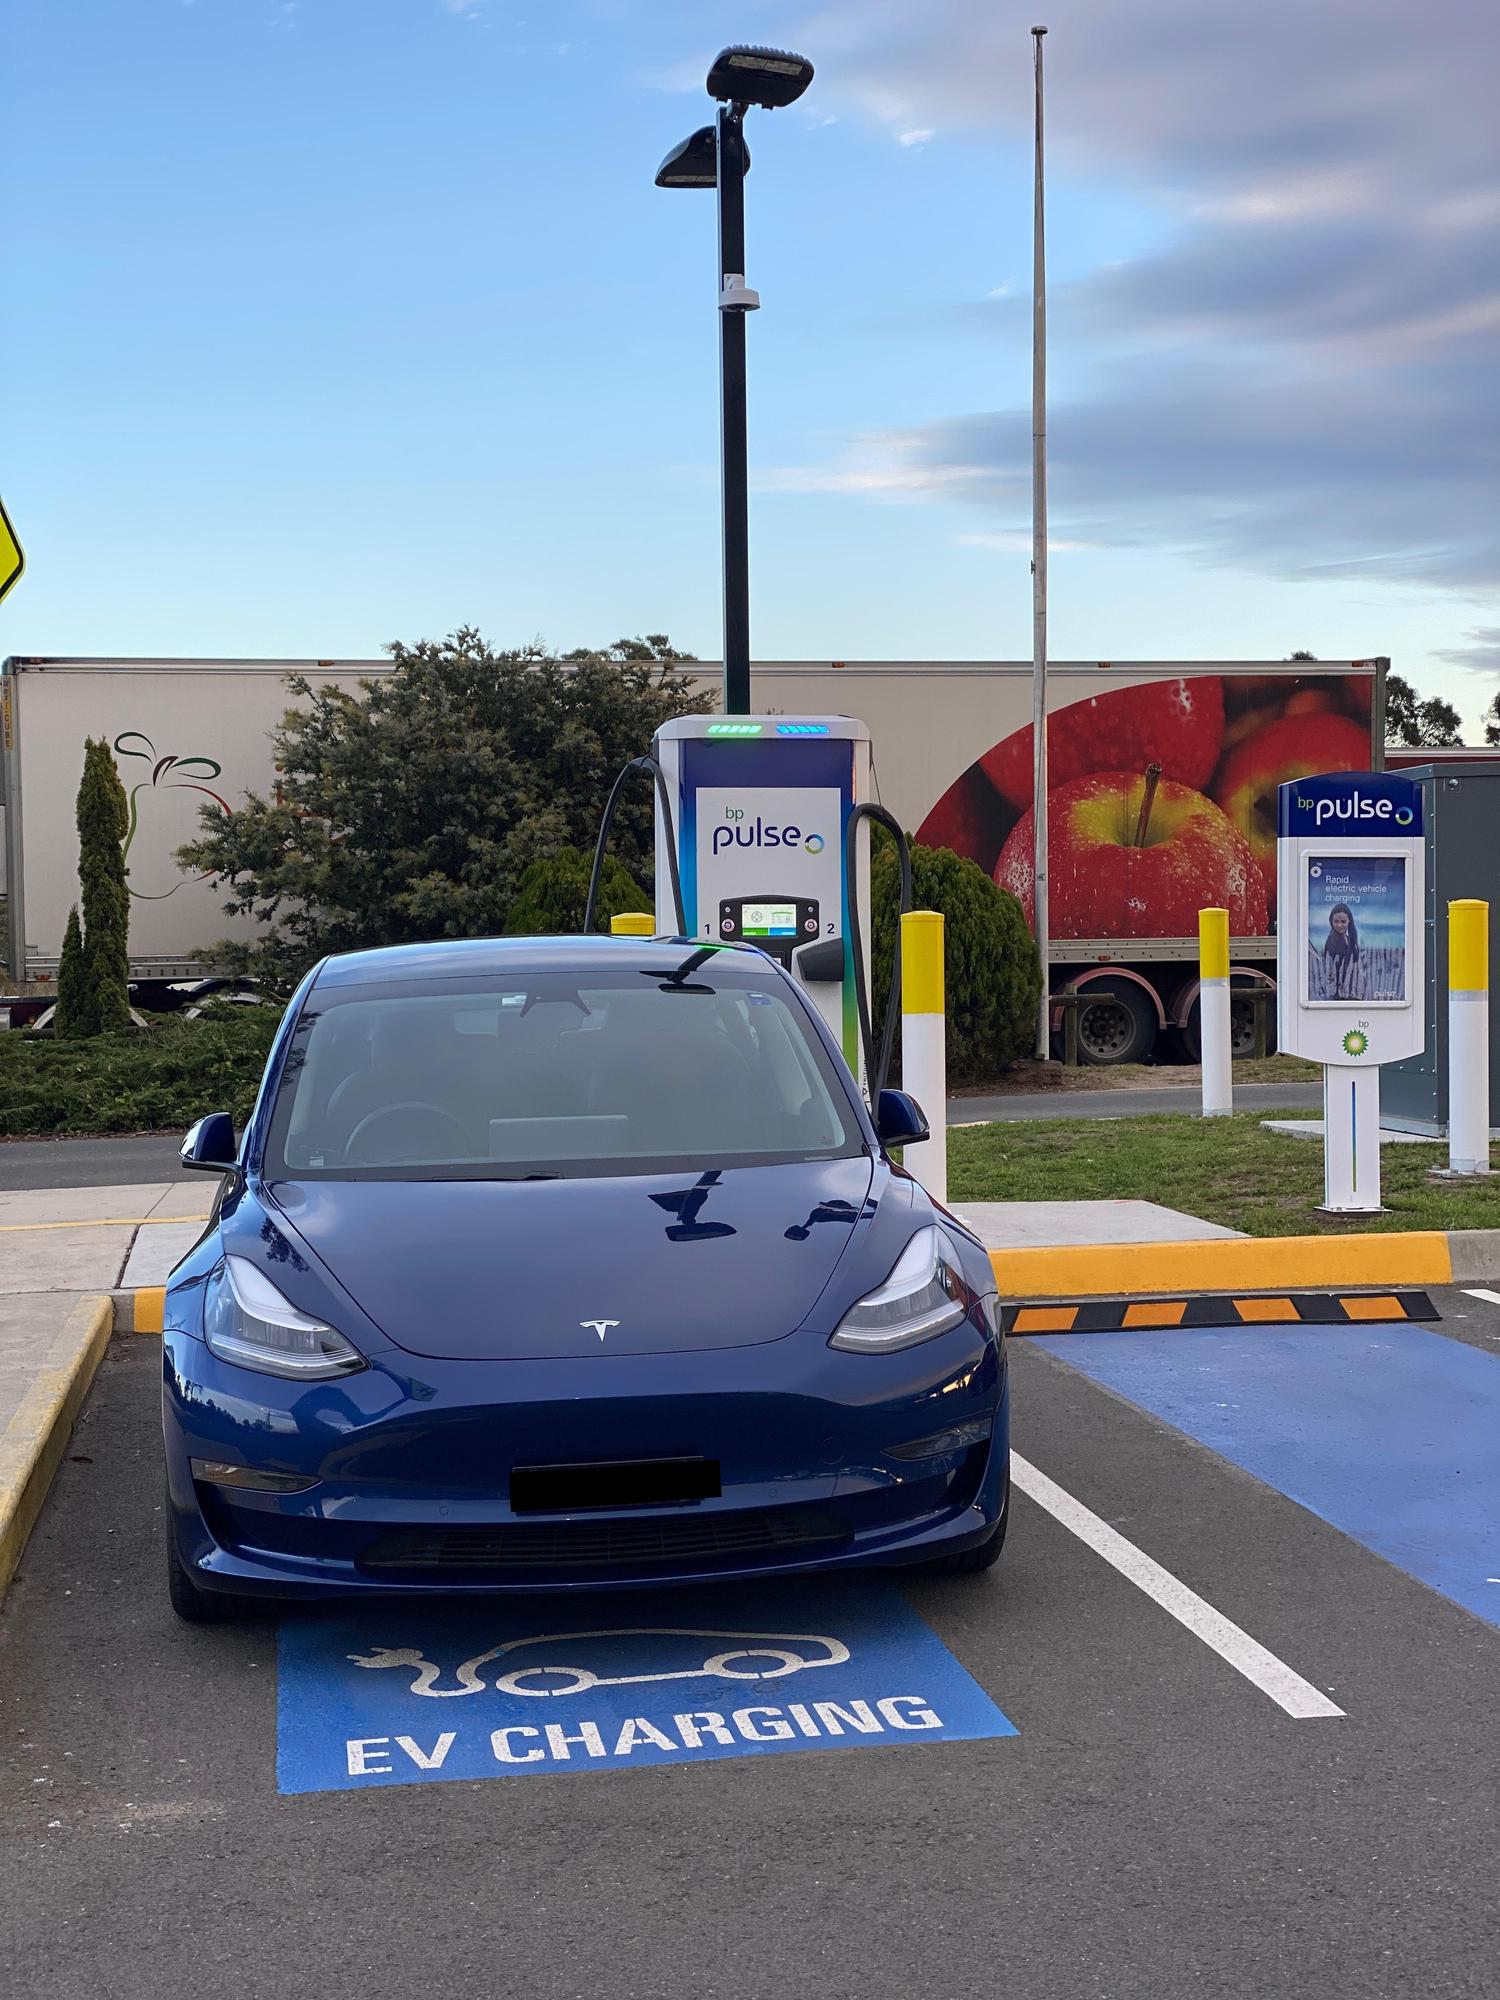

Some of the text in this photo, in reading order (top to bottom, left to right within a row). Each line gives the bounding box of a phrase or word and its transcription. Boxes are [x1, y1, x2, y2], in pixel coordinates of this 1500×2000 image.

[1298, 791, 1393, 825] bp pulse
[725, 806, 744, 823] bp
[713, 817, 801, 855] pulse
[1325, 875, 1349, 884] Rapid
[1325, 894, 1360, 903] charging
[704, 924, 710, 934] 1
[827, 923, 835, 934] 2
[1358, 1019, 1369, 1029] bp
[347, 1697, 944, 1776] EV CHARGING
